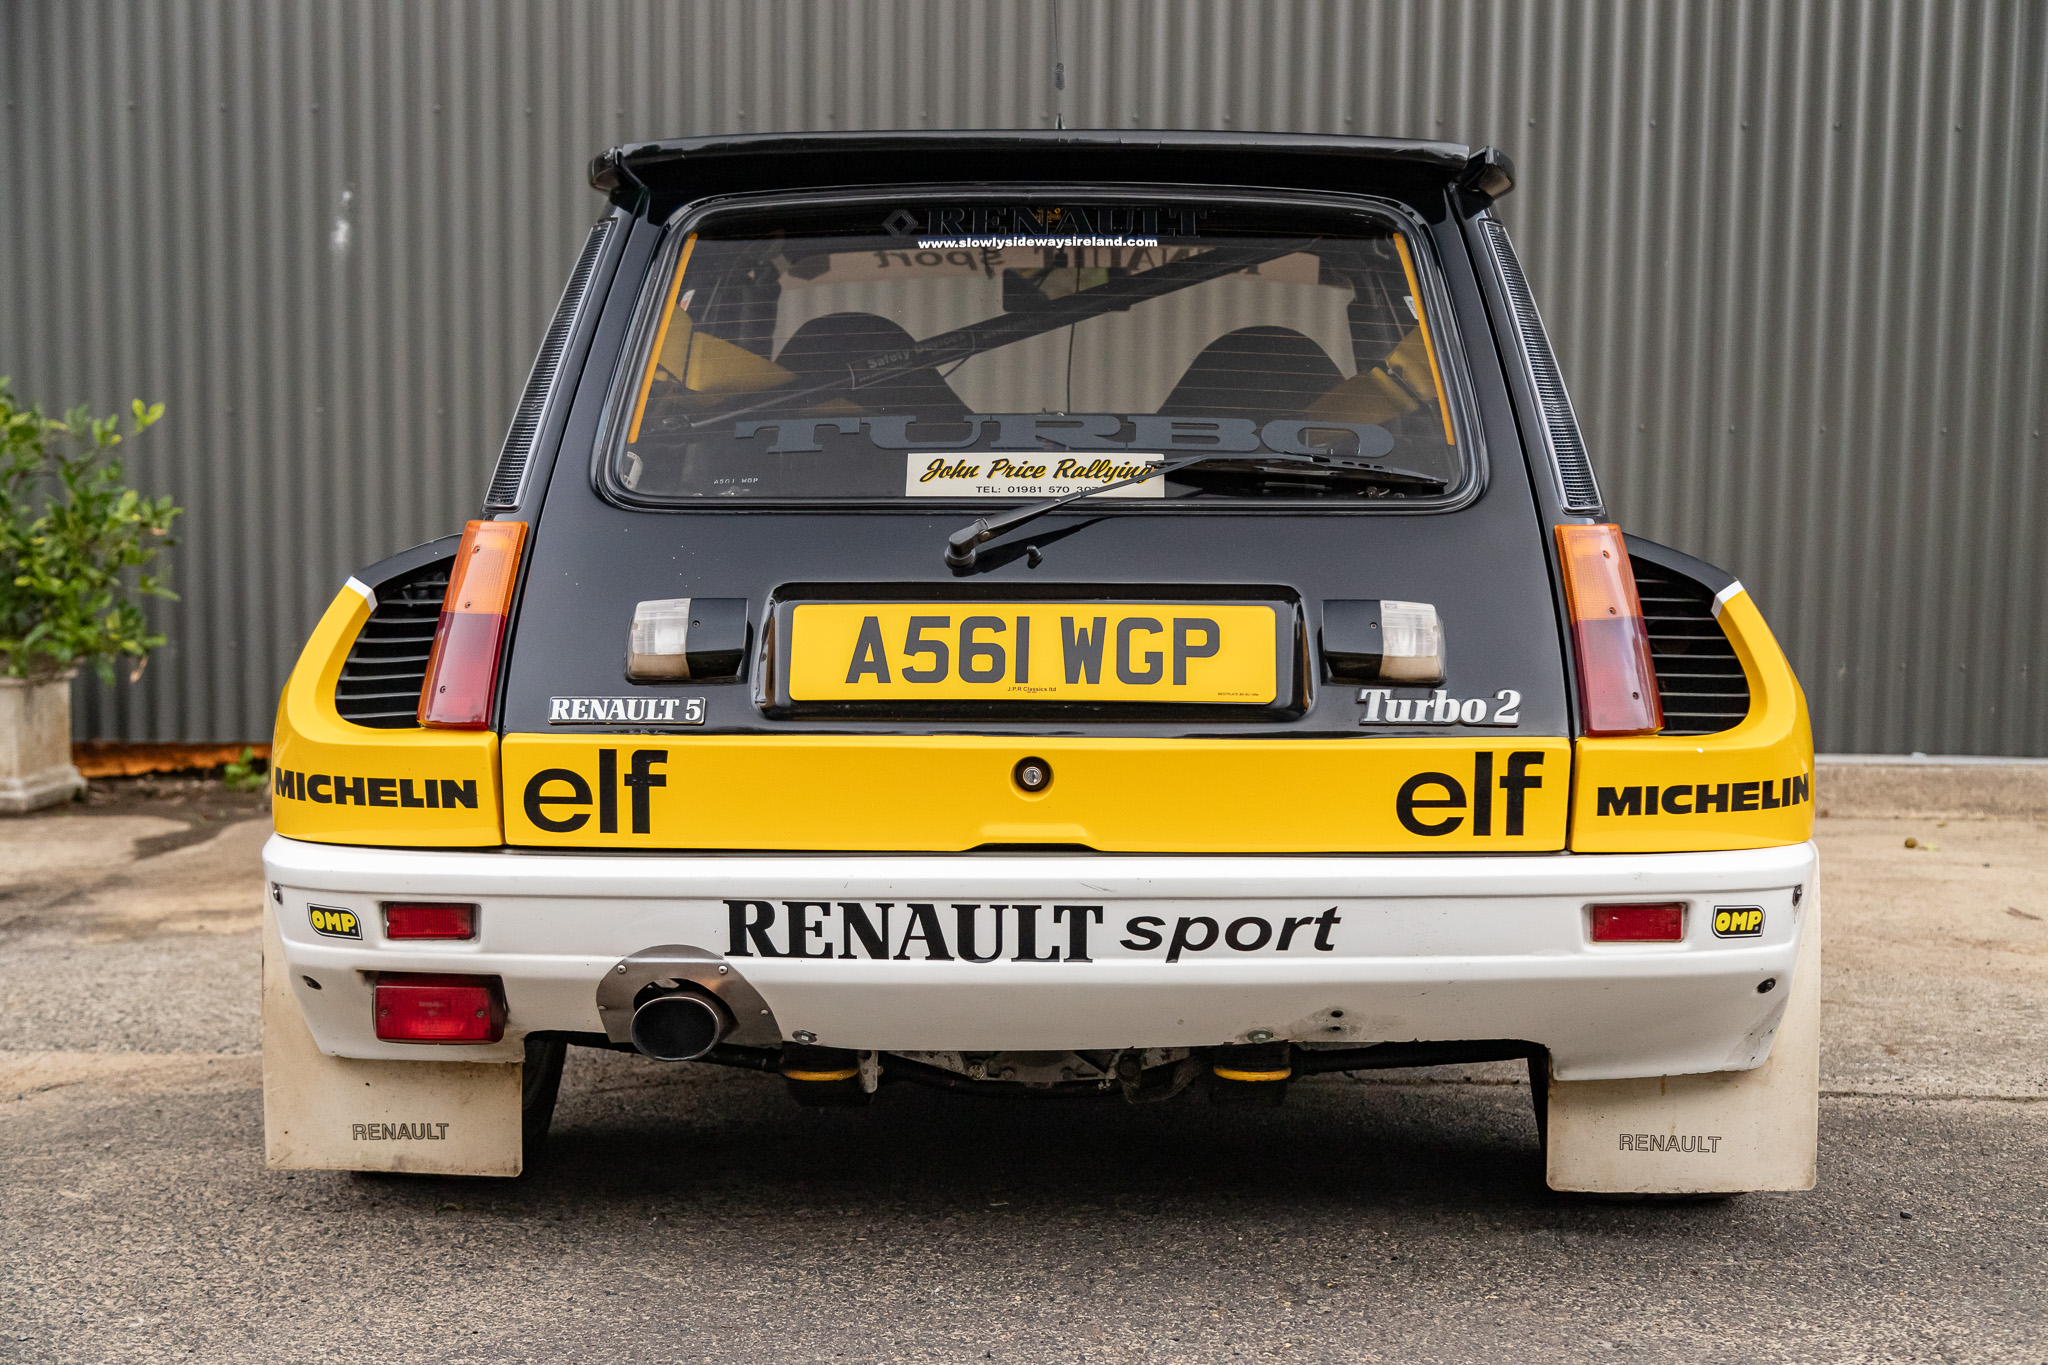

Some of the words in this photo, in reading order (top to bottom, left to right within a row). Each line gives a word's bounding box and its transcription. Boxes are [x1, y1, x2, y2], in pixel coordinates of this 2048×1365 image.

[927, 206, 1208, 237] RENAULT
[918, 235, 1158, 250] www.slowlysidewaysireland.com
[866, 347, 911, 369] Safety
[735, 413, 1395, 458] TURBO
[919, 457, 981, 483] John
[986, 457, 1047, 479] Price
[1052, 457, 1156, 485] Rallying
[975, 485, 1002, 494] TEL:
[1007, 485, 1043, 494] 01981
[1048, 485, 1071, 494] 570
[845, 615, 1030, 684] A561
[1060, 616, 1221, 685] WGP
[549, 698, 680, 721] RENAULT
[684, 699, 703, 721] 5
[1359, 688, 1488, 723] Turbo
[1493, 689, 1523, 723] 2
[275, 766, 479, 810] MICHELIN
[523, 748, 669, 834] elf
[1396, 751, 1545, 837] elf
[1596, 772, 1810, 817] MICHELIN
[311, 910, 356, 933] OMP
[722, 899, 1104, 964] RENAULT
[1119, 905, 1343, 964] sport
[1715, 910, 1763, 932] OMP
[352, 1122, 450, 1141] RENAULT
[1619, 1133, 1722, 1154] RENAULT
